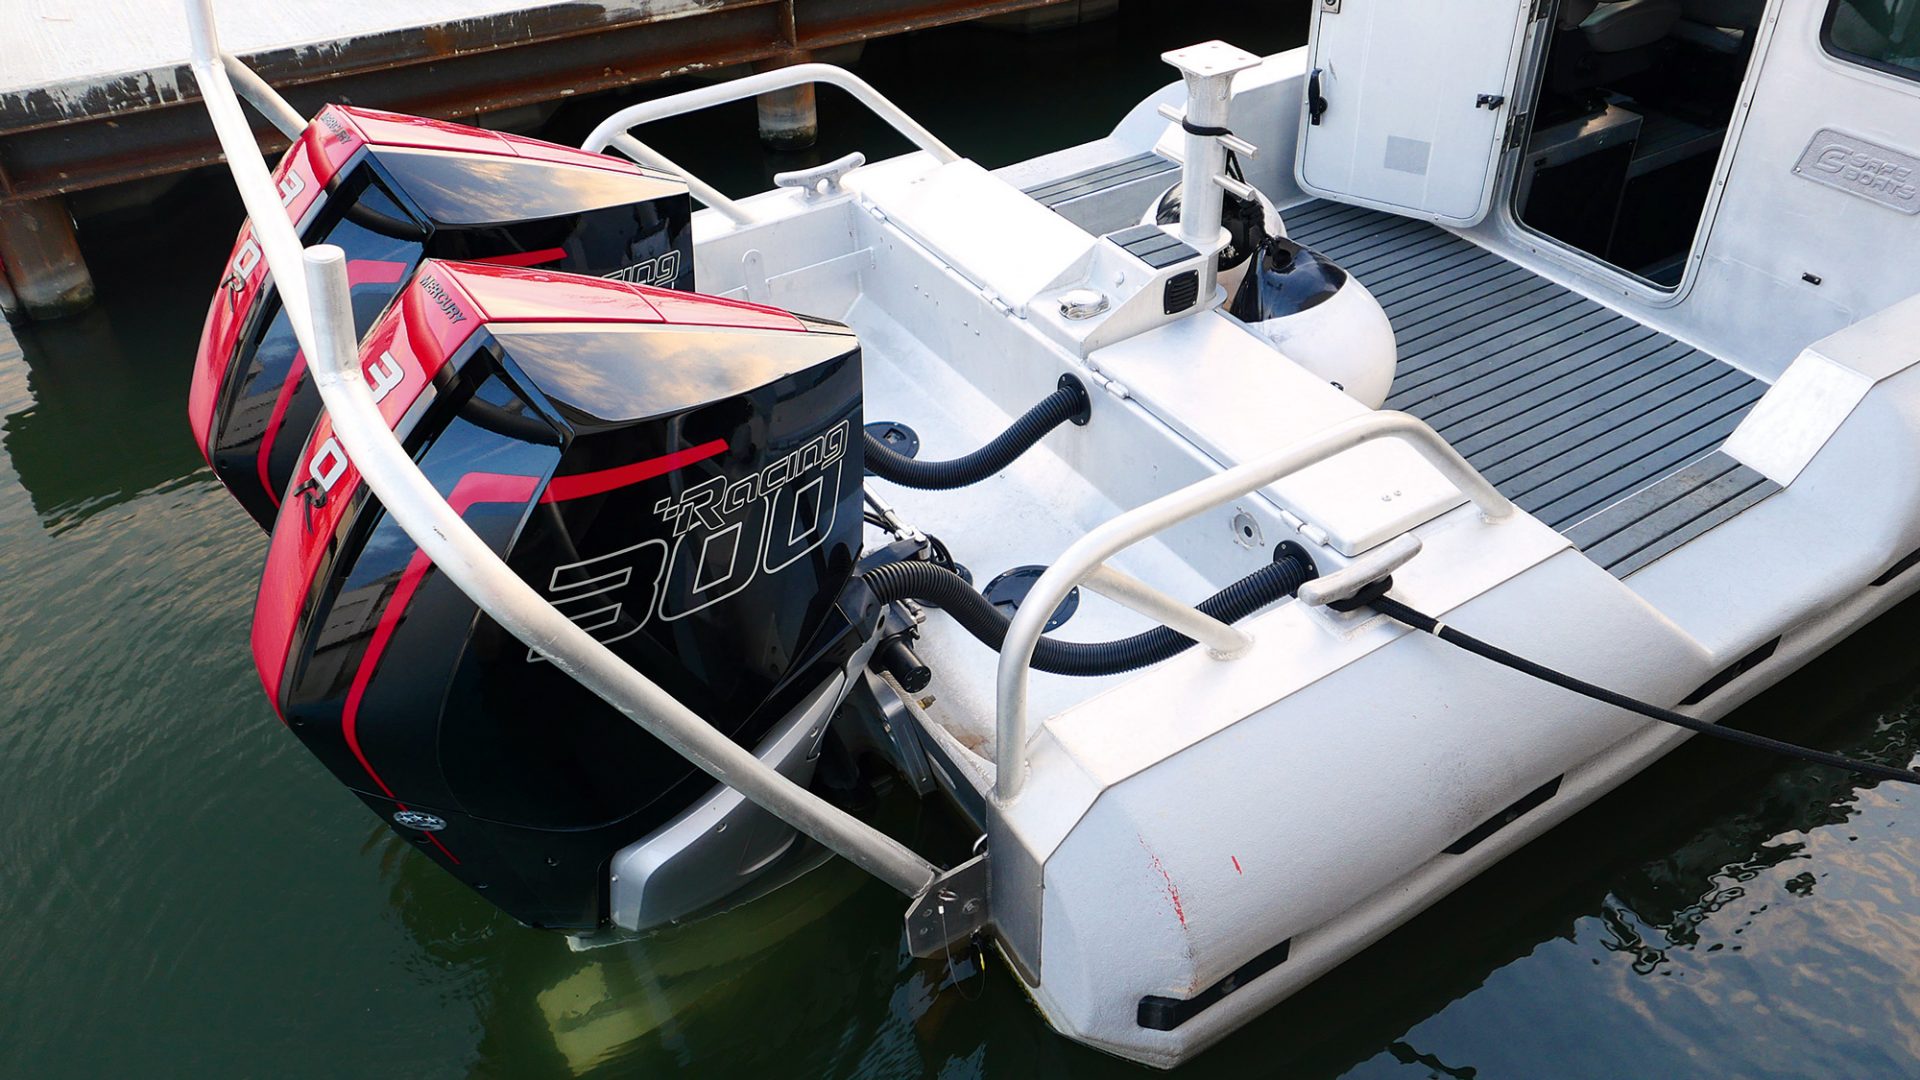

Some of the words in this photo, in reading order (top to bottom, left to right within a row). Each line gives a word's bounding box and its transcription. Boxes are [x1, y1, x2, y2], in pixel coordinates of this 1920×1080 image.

[320, 112, 352, 144] MERCURY
[419, 275, 467, 325] MERCURY
[309, 350, 405, 492] 30
[654, 419, 850, 537] Racing
[527, 459, 843, 663] 300
